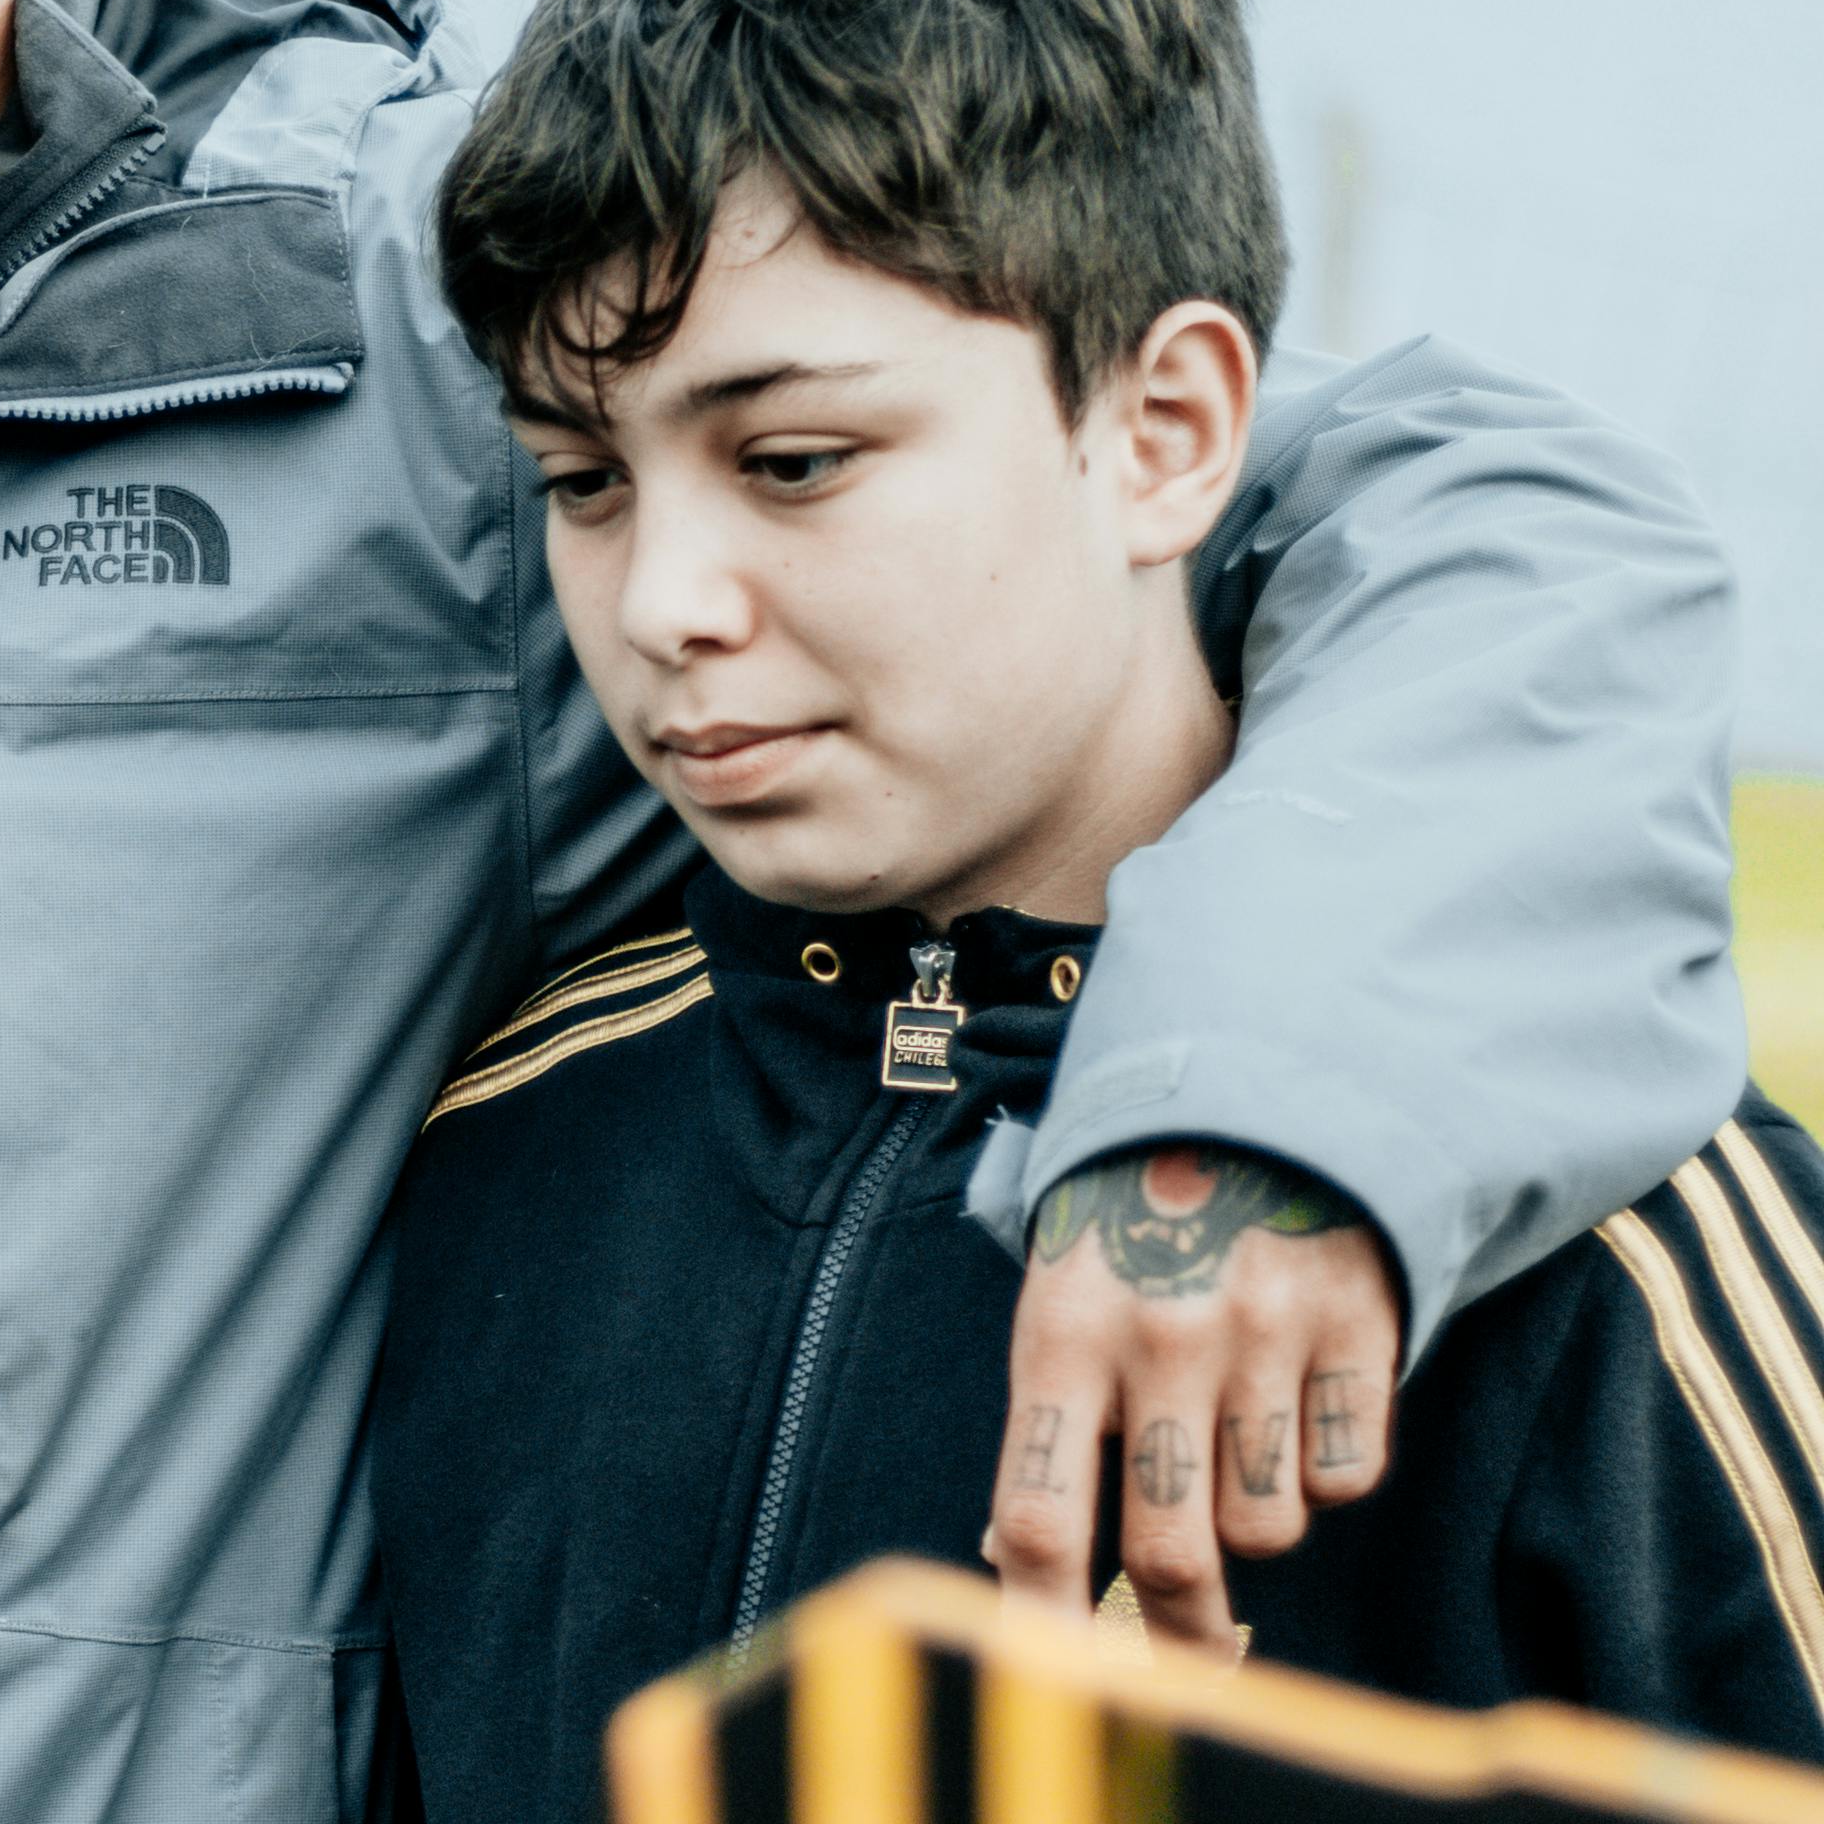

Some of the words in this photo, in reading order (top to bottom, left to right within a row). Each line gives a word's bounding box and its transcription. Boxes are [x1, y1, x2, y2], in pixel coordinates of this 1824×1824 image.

[66, 484, 152, 518] THE
[2, 520, 151, 560] NORTH
[38, 553, 150, 587] FACE
[896, 1031, 948, 1048] adidas
